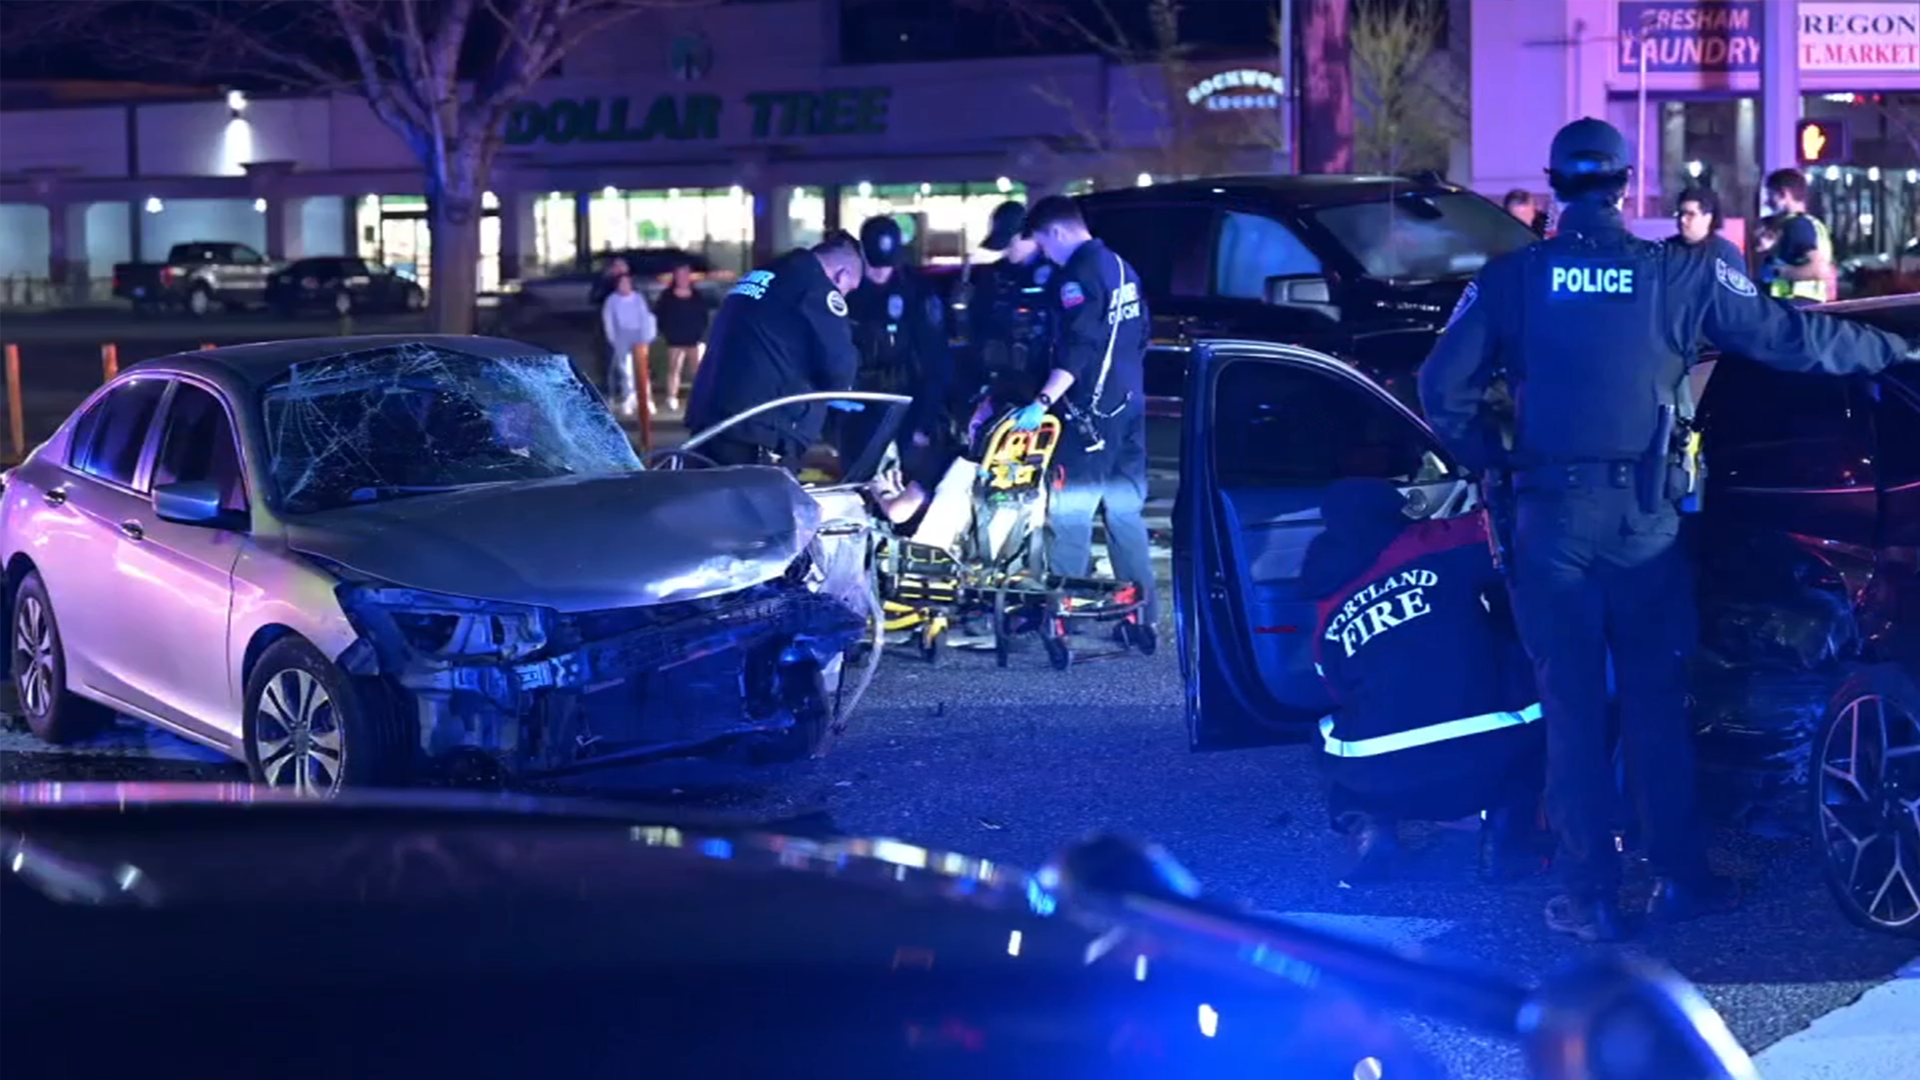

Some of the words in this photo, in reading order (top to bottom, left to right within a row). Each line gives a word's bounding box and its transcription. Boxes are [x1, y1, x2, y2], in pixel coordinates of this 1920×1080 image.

[1804, 14, 1916, 35] REGON
[1622, 36, 1759, 64] LAUNDRY
[1825, 43, 1918, 64] MARKET
[1187, 69, 1284, 104] ROCKWOO
[505, 92, 721, 144] DOLLAR
[746, 87, 891, 137] TREE
[1552, 267, 1634, 293] POLICE
[1325, 569, 1439, 642] PORTLAND
[1341, 587, 1432, 658] FIRE
